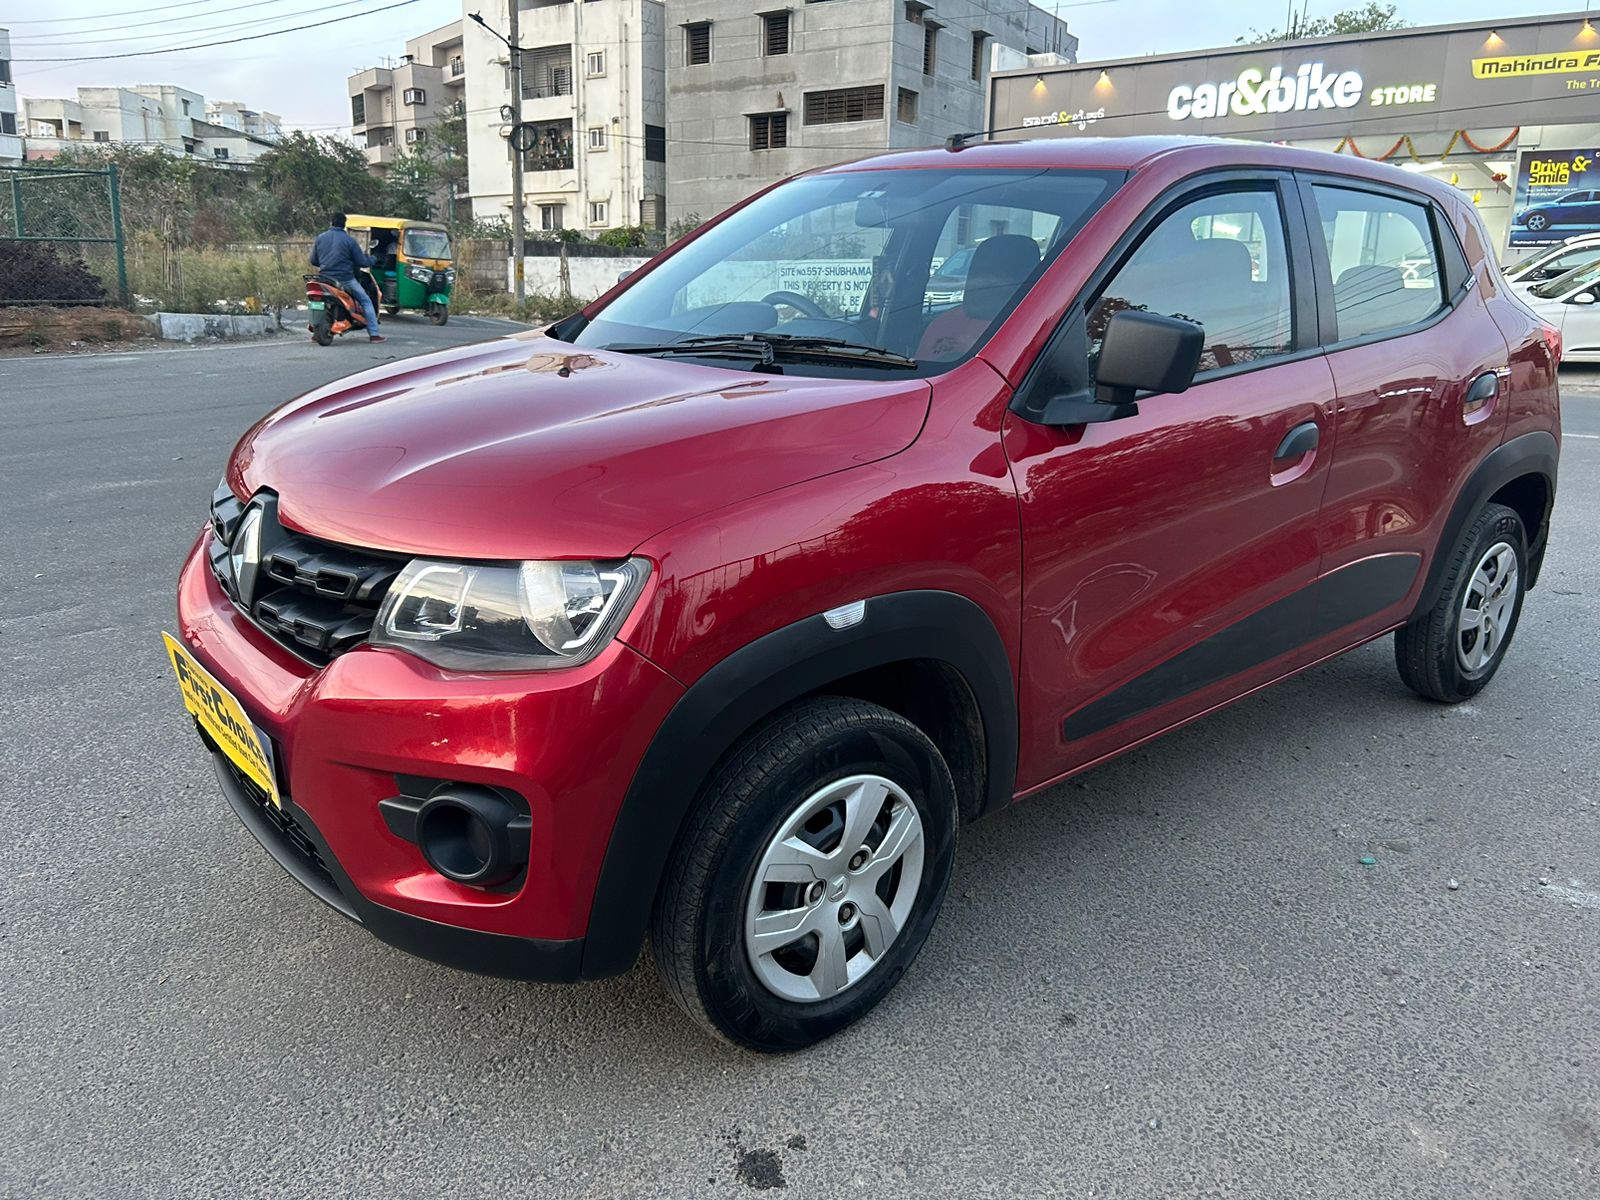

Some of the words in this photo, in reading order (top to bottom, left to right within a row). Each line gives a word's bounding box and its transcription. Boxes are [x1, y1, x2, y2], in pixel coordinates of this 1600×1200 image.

[1481, 57, 1578, 74] Mahindra
[1566, 80, 1587, 89] The
[1167, 63, 1363, 120] car&bike
[1370, 84, 1437, 106] STORE
[1530, 159, 1569, 173] Drive
[1572, 155, 1592, 172] &
[1529, 170, 1568, 183] Smile
[780, 267, 795, 277] SITE
[784, 281, 799, 290] THIS
[803, 281, 842, 290] PROPERTY
[844, 281, 851, 290] IS
[853, 281, 869, 290] NOT
[850, 295, 860, 306] BE
